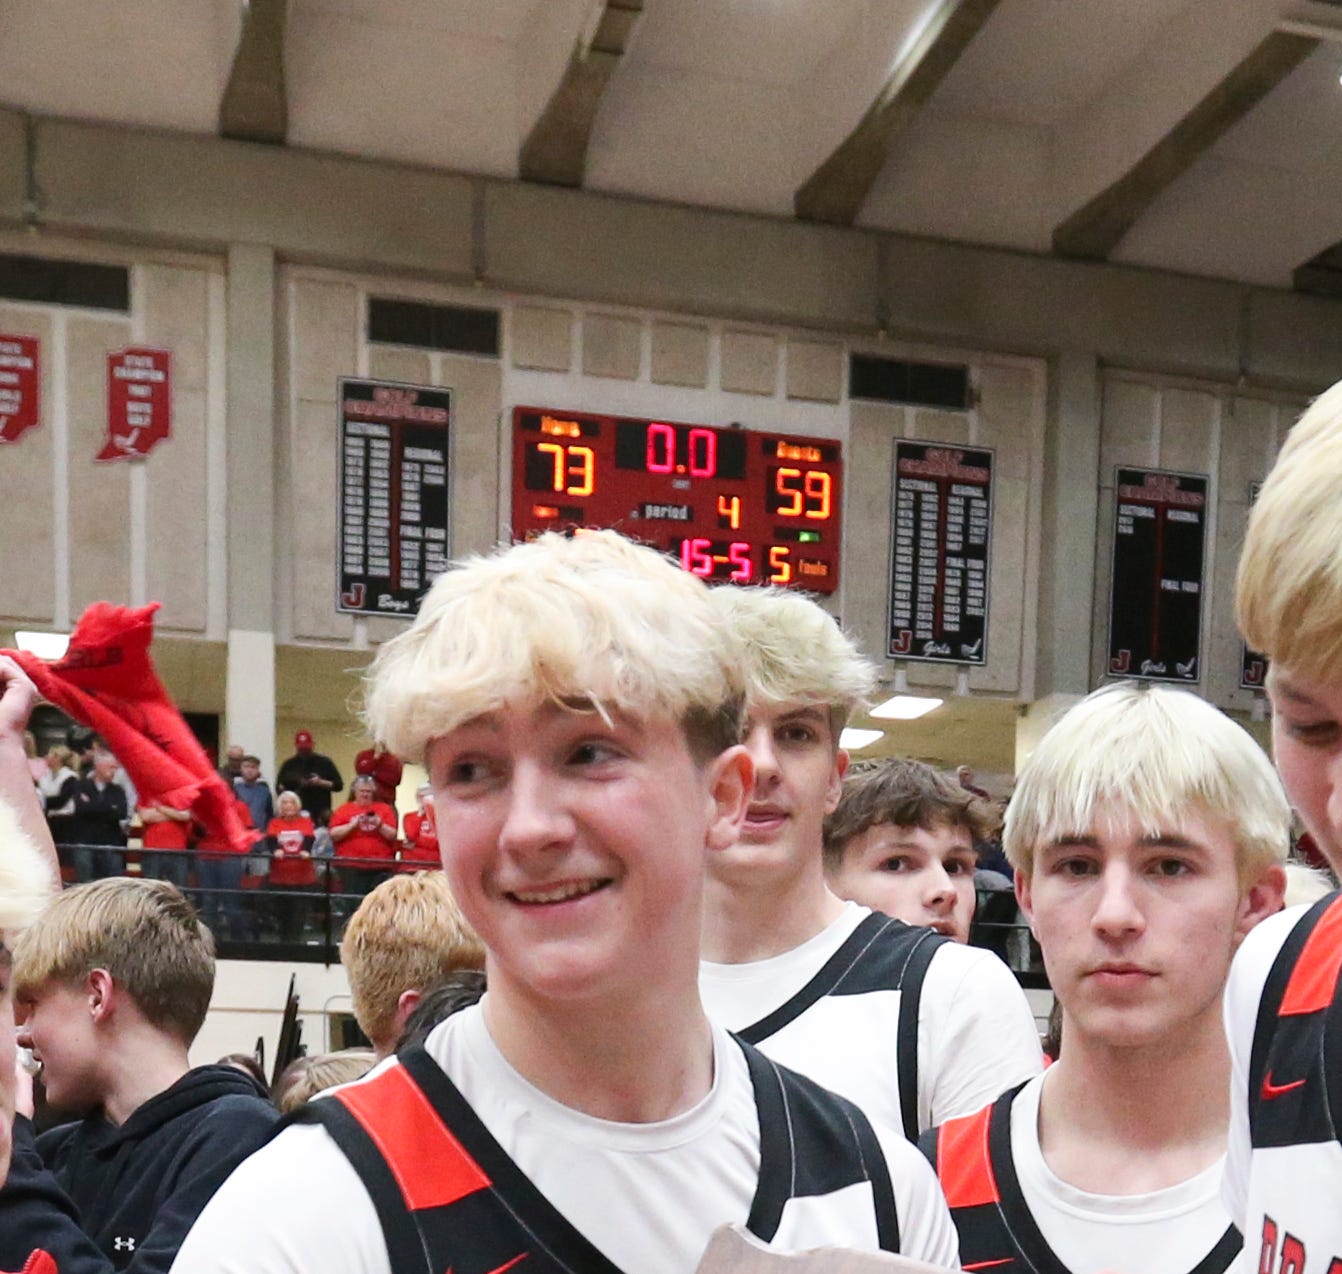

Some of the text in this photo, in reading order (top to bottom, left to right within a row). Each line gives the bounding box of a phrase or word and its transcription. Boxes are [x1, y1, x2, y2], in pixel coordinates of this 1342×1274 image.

[537, 443, 595, 497] 73
[646, 422, 717, 478] 0.0
[645, 495, 742, 530] period 4
[776, 467, 832, 519] 59
[341, 582, 368, 608] J
